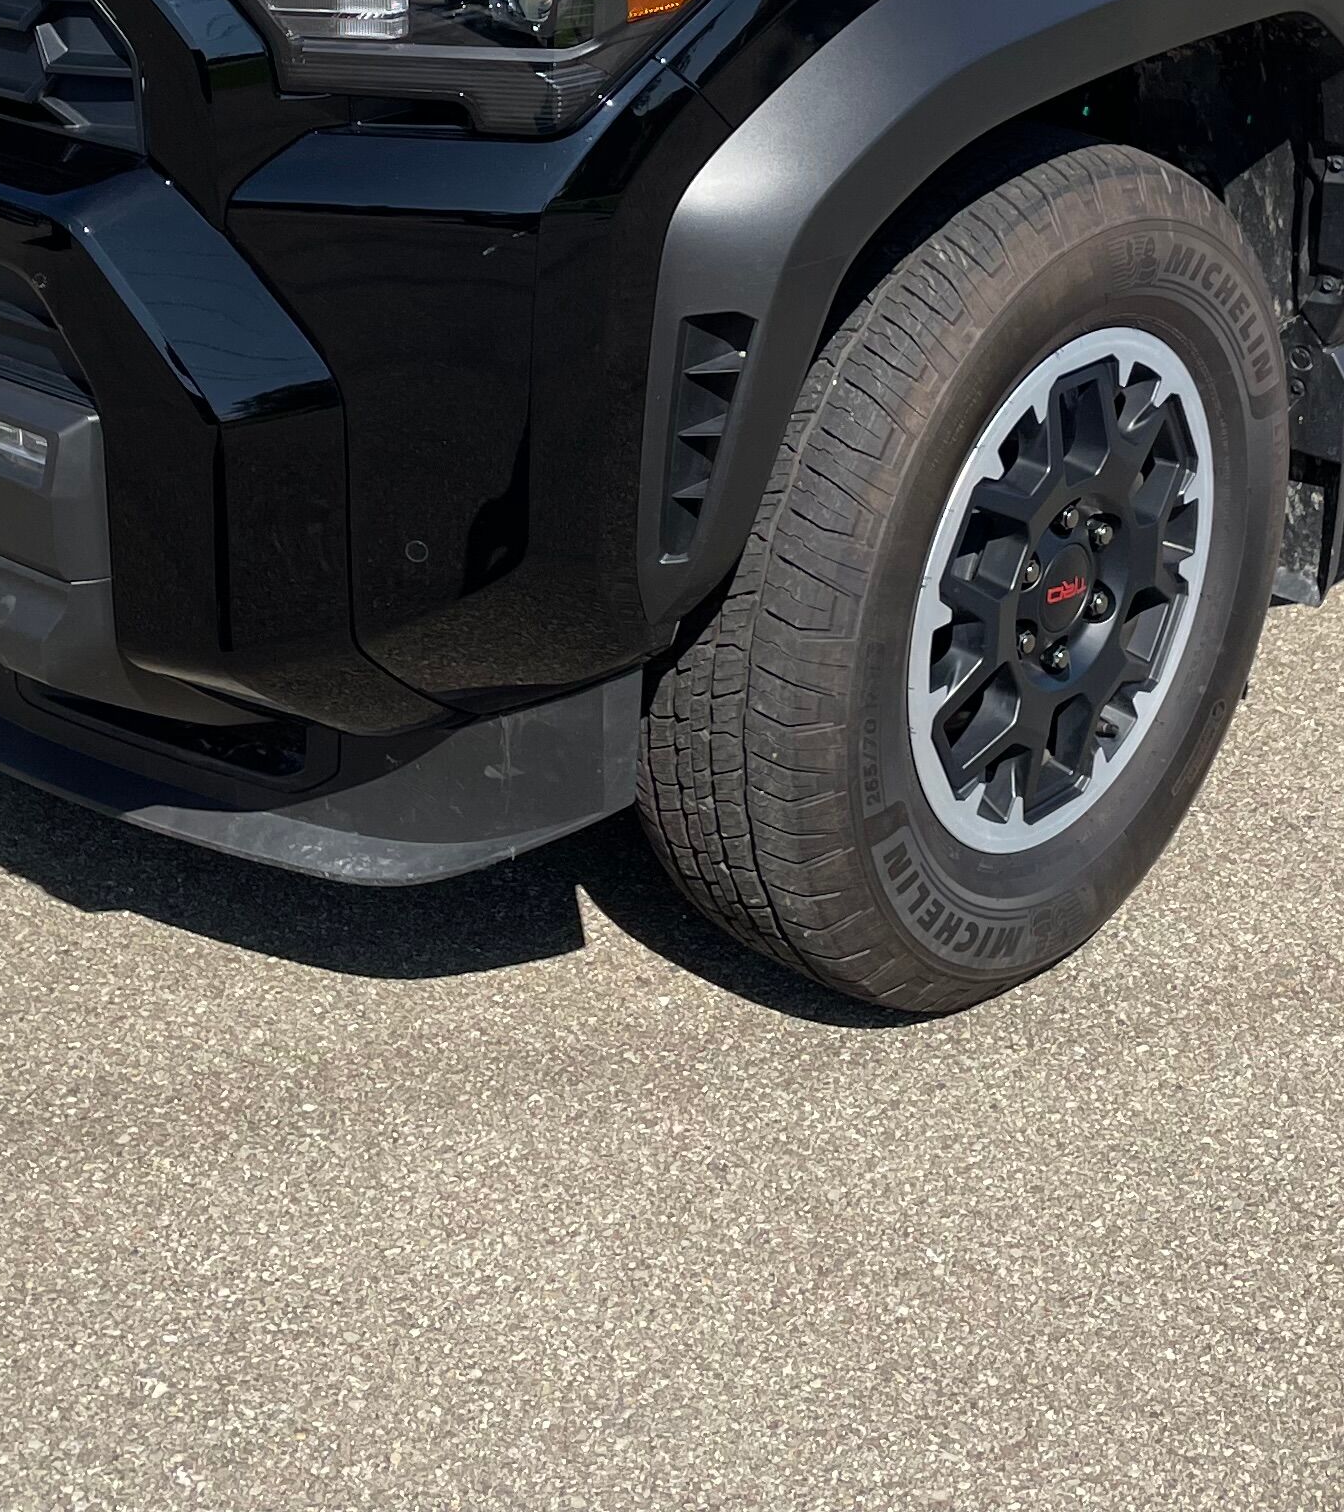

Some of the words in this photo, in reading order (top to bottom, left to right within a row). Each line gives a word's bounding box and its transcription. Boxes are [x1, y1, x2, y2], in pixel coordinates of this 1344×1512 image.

[1164, 243, 1274, 384] MICHELIN
[1047, 576, 1087, 604] TRD
[883, 841, 1025, 959] MICHELIN
